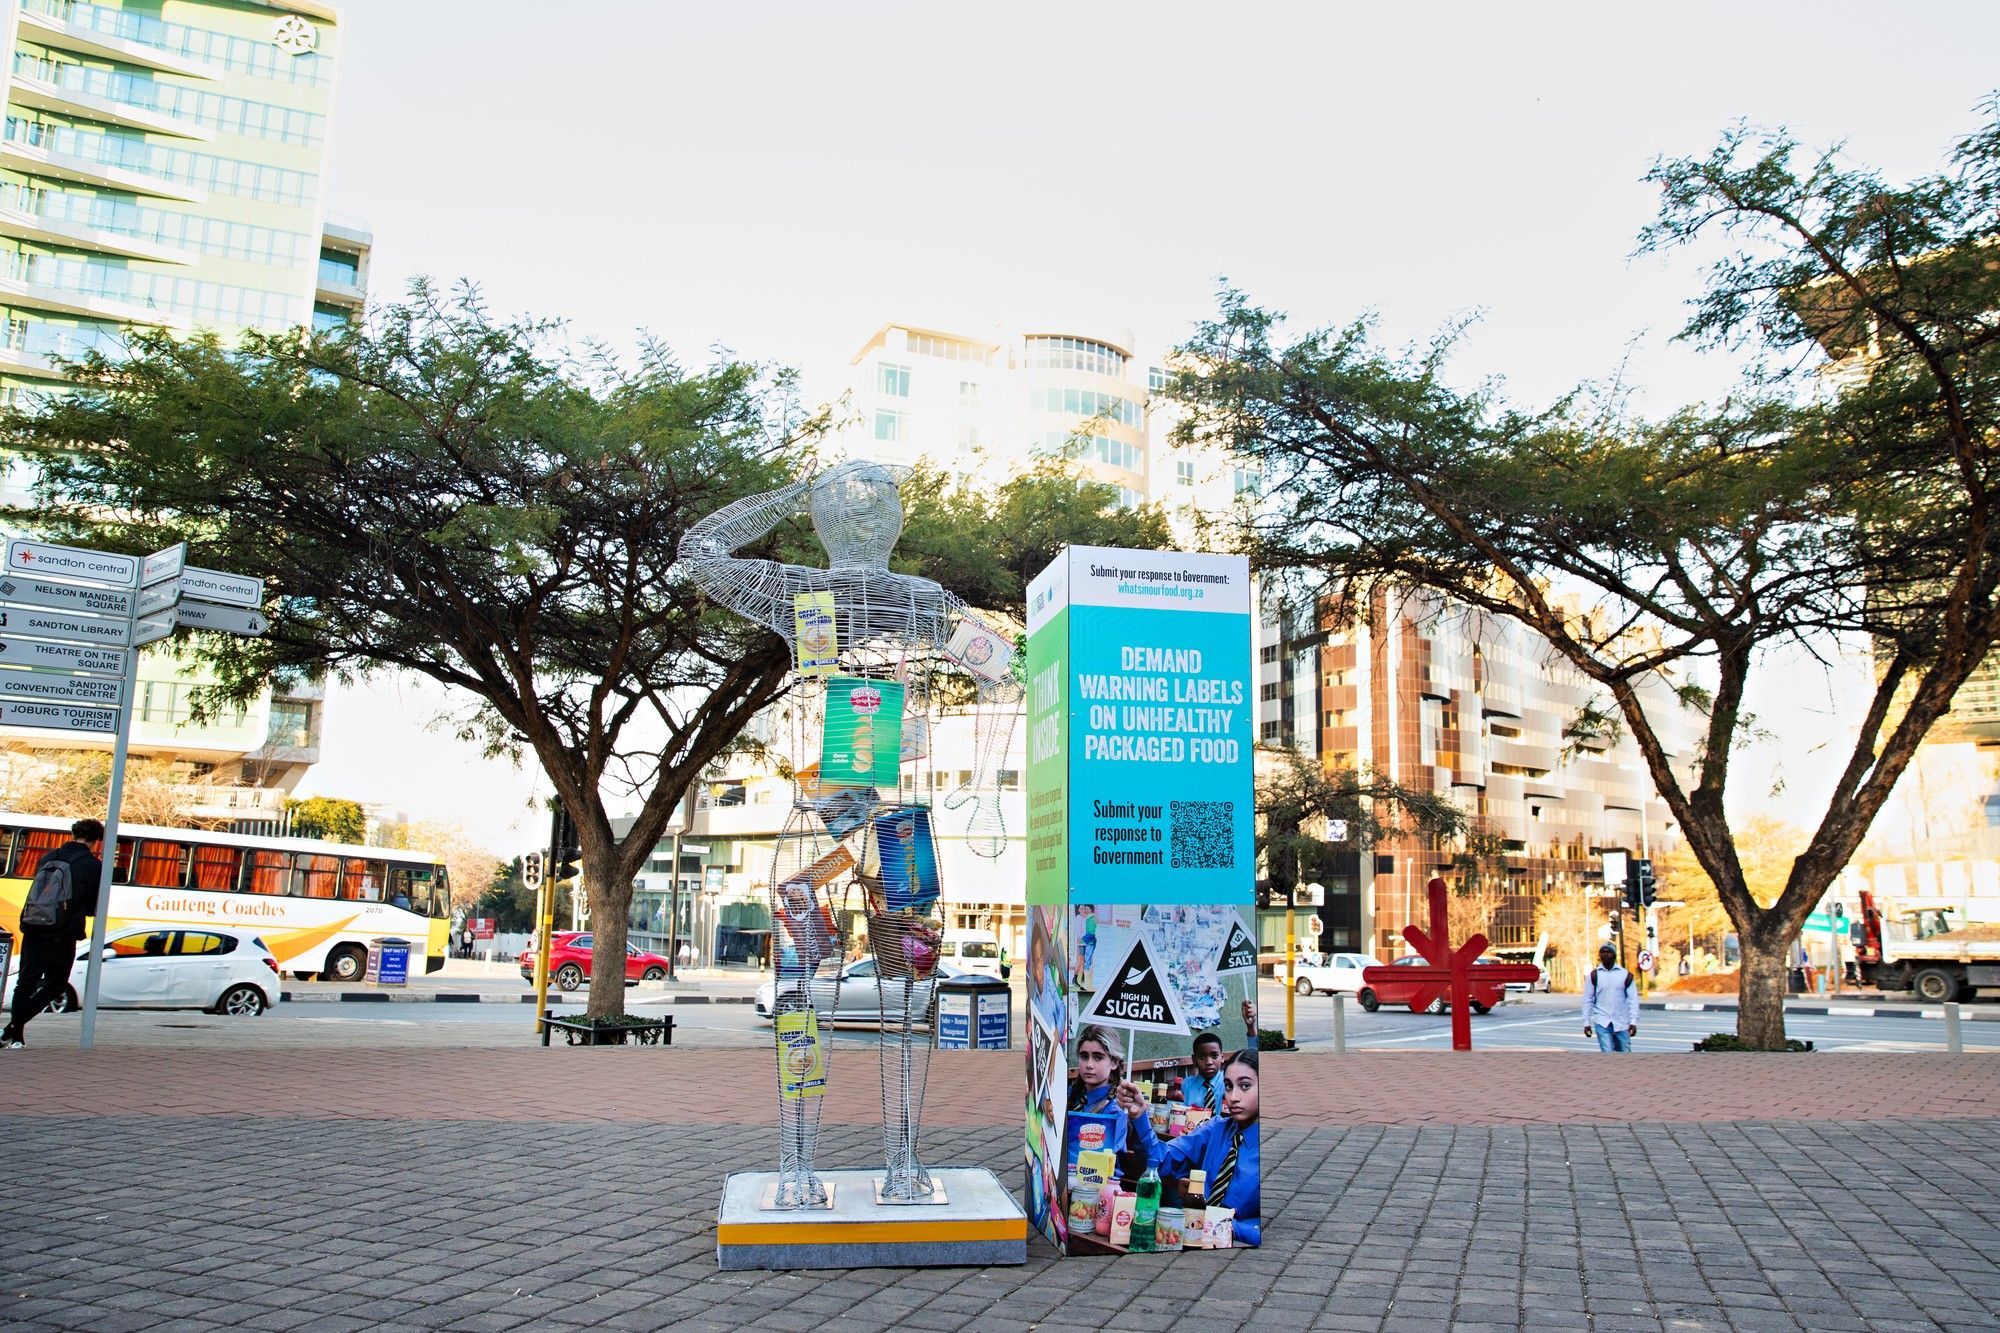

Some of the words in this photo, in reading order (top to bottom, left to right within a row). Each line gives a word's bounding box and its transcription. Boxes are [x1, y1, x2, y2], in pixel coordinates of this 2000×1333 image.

[38, 554, 85, 568] sandton
[88, 562, 127, 574] central
[1090, 564, 1118, 577] Submit
[1120, 570, 1136, 580] your
[1138, 570, 1172, 582] response
[1174, 572, 1182, 582] to
[1182, 570, 1230, 584] Government:
[35, 585, 76, 597] NELSON
[80, 592, 127, 604] MANDELA
[182, 577, 218, 590] andton
[220, 584, 253, 596] central
[1118, 582, 1204, 600] whatsinourfood.org.za
[86, 600, 127, 612] SQUARE
[29, 619, 78, 632] SANDTON
[81, 625, 124, 636] LIBRARY
[35, 645, 81, 656] THEATRE
[84, 650, 98, 658] ON
[102, 652, 120, 661] THE
[1122, 646, 1202, 674] DEMAND
[78, 660, 119, 670] SQUARE
[5, 682, 73, 695] CONVENTION
[76, 689, 116, 698] CENTRE
[69, 680, 117, 691] SANDTON
[1033, 659, 1060, 717] THINK
[1079, 674, 1168, 702] WARNING
[1174, 678, 1243, 704] LABELS
[11, 706, 60, 716] JOBURG
[63, 708, 112, 720] TOURISM
[1090, 704, 1116, 730] ON
[1122, 706, 1233, 734] UNHEALTHY
[72, 718, 111, 728] OFFICE
[1033, 710, 1060, 766] INSIDE
[1085, 734, 1184, 762] PACKAGED
[1190, 738, 1239, 764] FOOD
[1094, 800, 1135, 818] Submit
[1138, 804, 1163, 822] your
[1095, 827, 1148, 845] response
[1150, 826, 1162, 842] to
[1094, 846, 1164, 864] Government
[146, 895, 216, 916] Gauteng
[222, 899, 286, 916] Coaches
[1228, 955, 1253, 968] SALT
[1120, 992, 1140, 1002] HIGH
[1140, 994, 1150, 1002] IN
[1105, 999, 1164, 1021] SUGAR
[1080, 1166, 1098, 1175] CREAMY
[1083, 1175, 1104, 1184] CUSTARD
